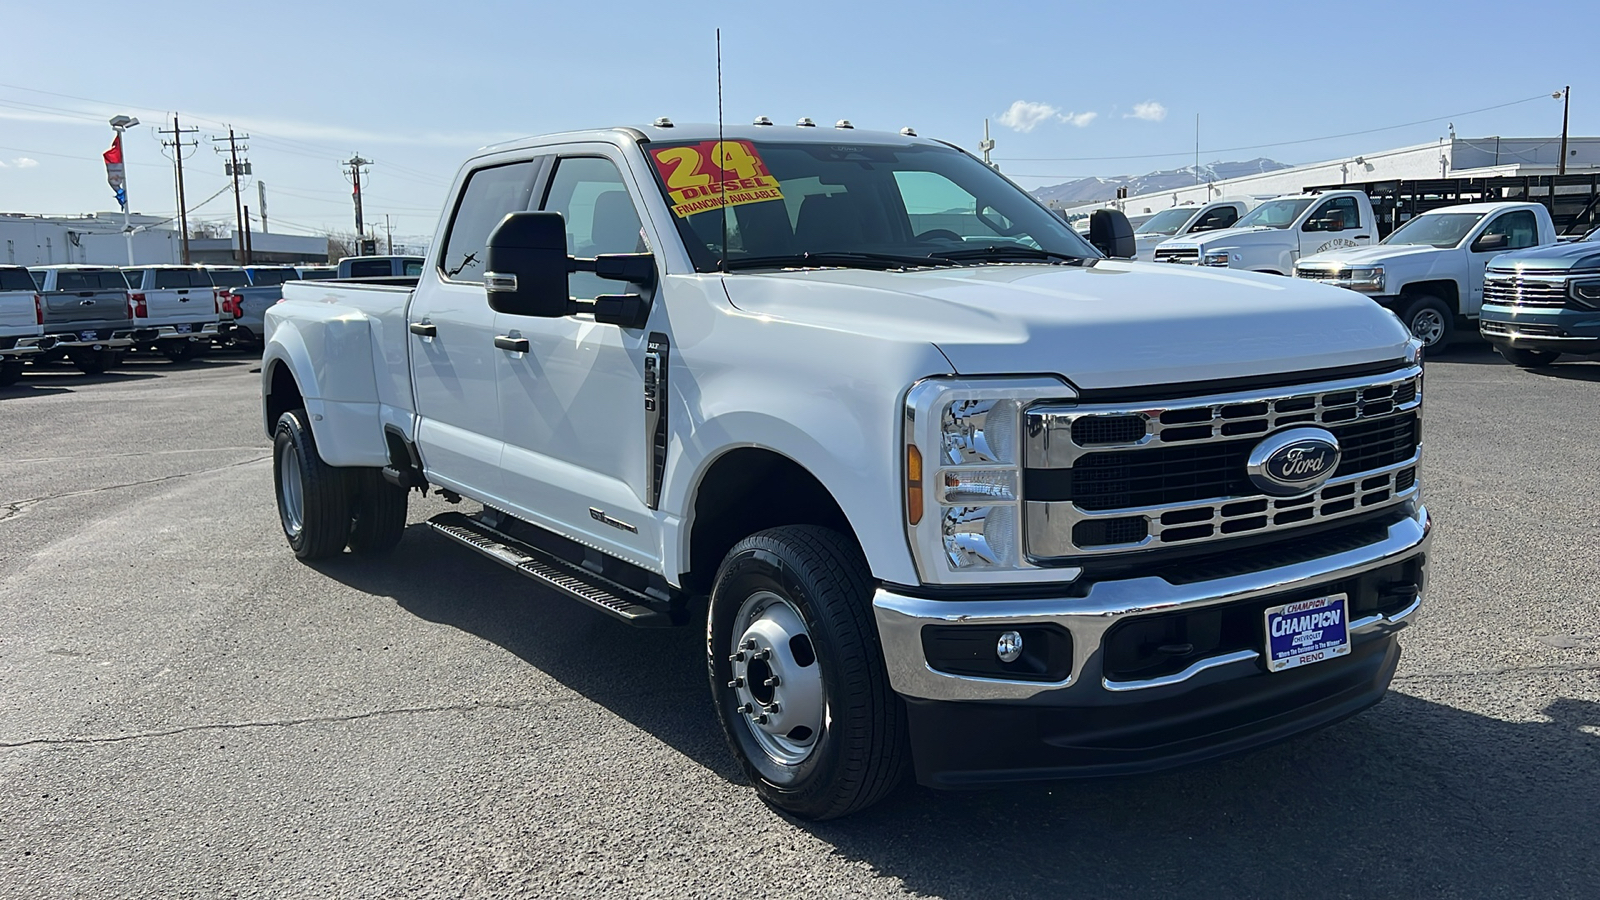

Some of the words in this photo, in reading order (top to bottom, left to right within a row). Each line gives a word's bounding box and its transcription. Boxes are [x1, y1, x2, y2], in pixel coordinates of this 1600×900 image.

[656, 141, 761, 188] 24
[681, 177, 771, 199] DIESEL
[676, 196, 729, 215] FINANCING
[729, 189, 780, 204] AVAILABLE
[1317, 240, 1331, 253] CITY
[1282, 447, 1325, 476] Ford
[1287, 599, 1326, 613] CHAMPION
[1271, 609, 1341, 637] CHAMPION
[1294, 632, 1321, 643] CHEVROLET
[1300, 652, 1325, 664] RENO
